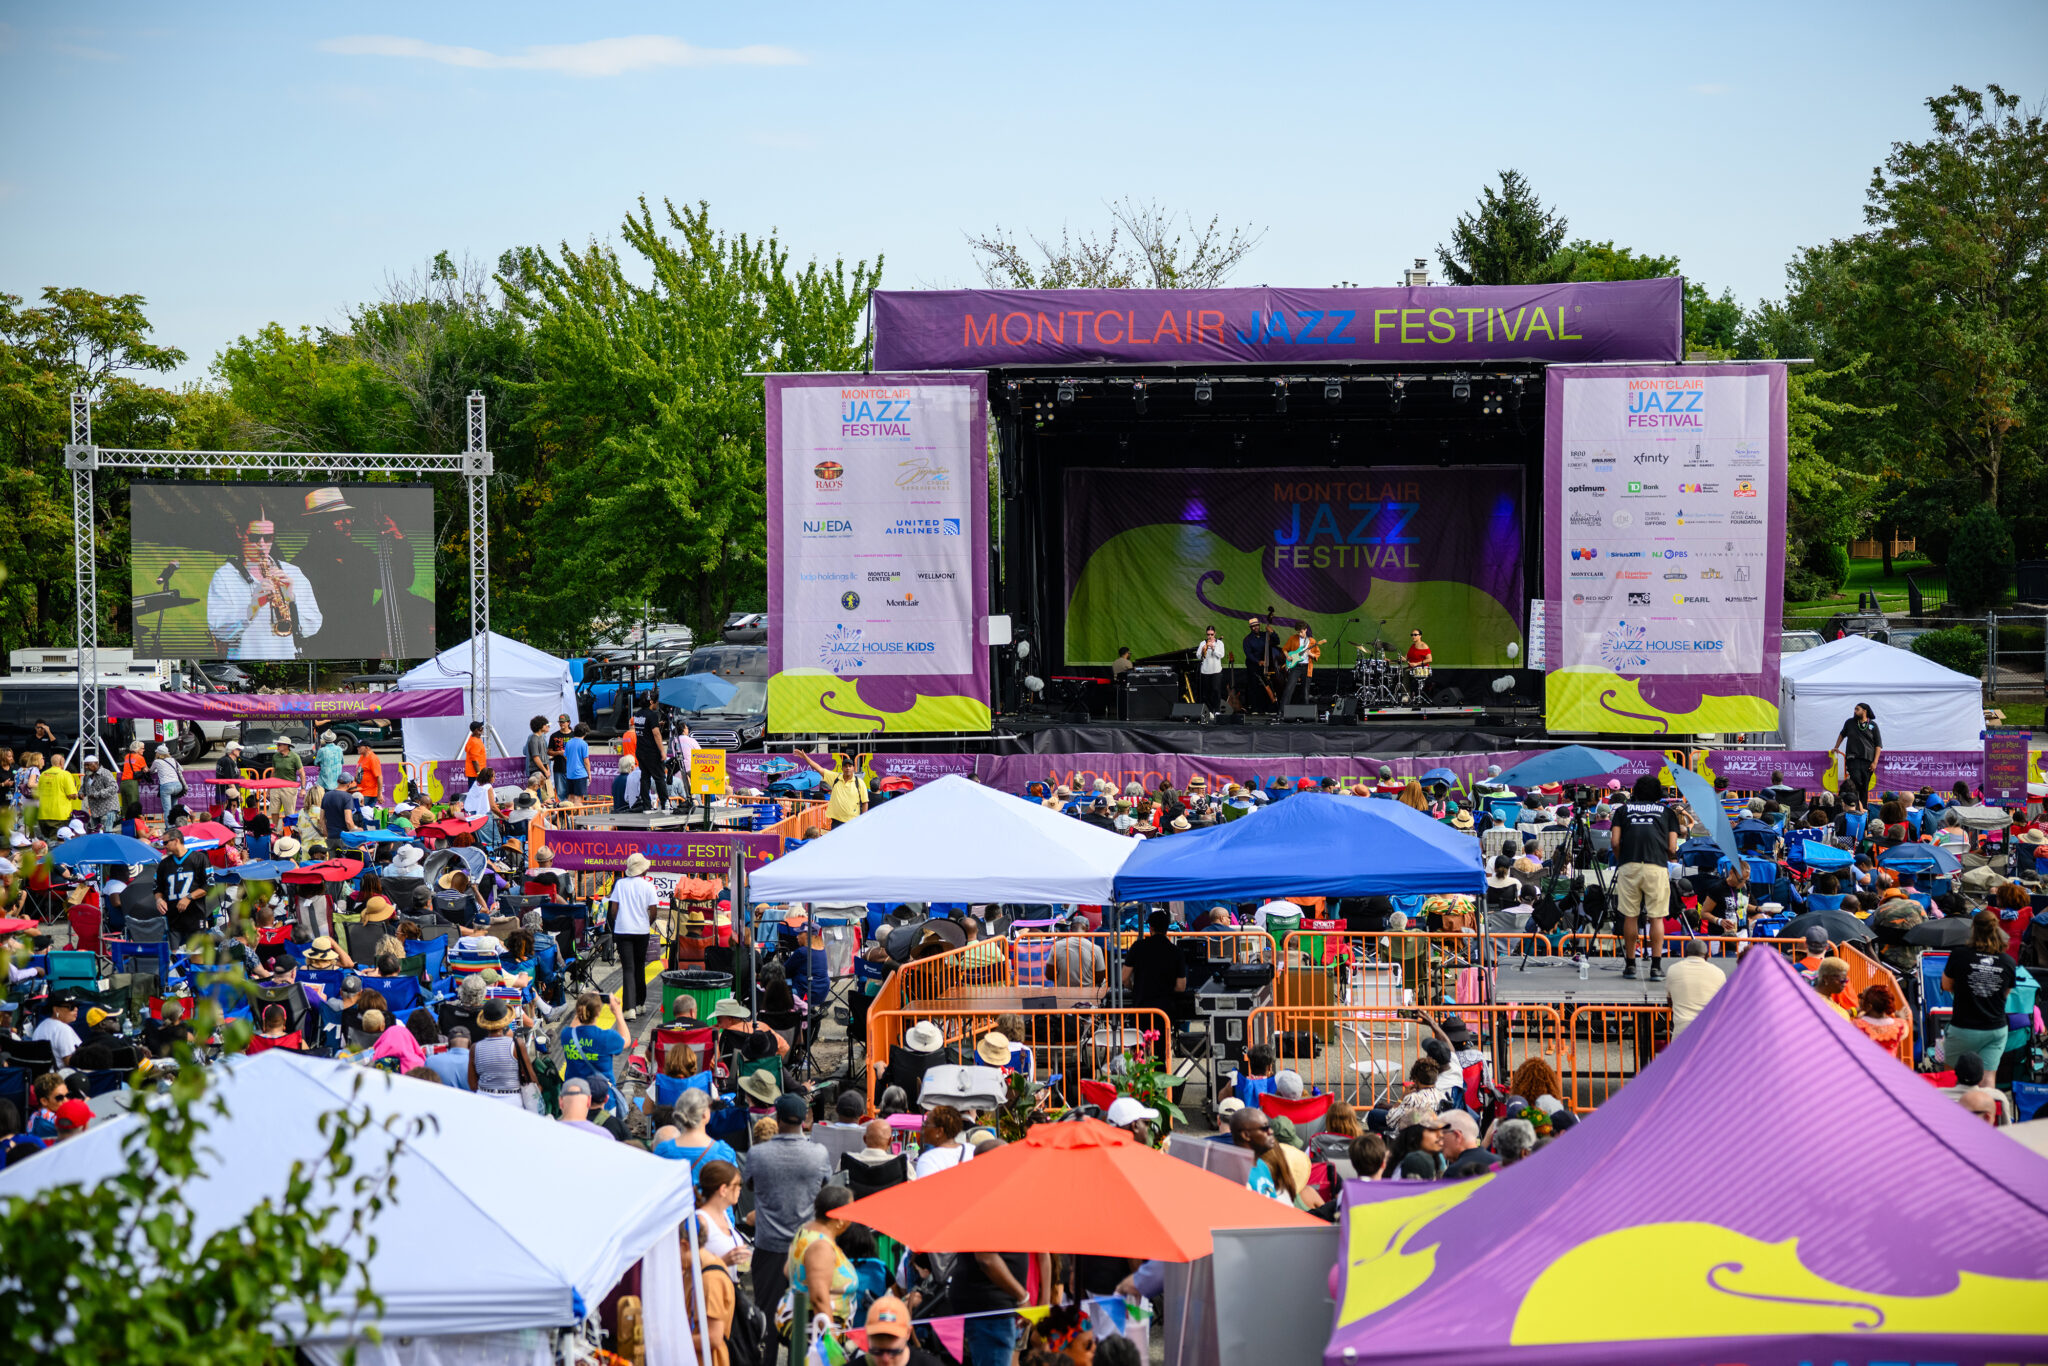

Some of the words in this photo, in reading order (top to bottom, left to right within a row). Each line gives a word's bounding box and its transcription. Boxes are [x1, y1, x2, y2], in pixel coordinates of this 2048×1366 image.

[964, 309, 1225, 347] MONTCLAIR
[1236, 310, 1356, 344] JAZZ
[1628, 379, 1704, 390] MONTCLAIR
[841, 389, 911, 400] MONTCLAIR
[1628, 391, 1704, 413] JAZZ
[841, 400, 911, 422] JAZZ
[1628, 414, 1704, 428] FESTIVAL
[841, 423, 911, 436] FESTIVAL
[1633, 452, 1670, 465] xfinity
[815, 480, 843, 489] RAO'S
[1678, 483, 1703, 493] CMA
[1273, 482, 1420, 501] MONTCLAIR
[896, 519, 940, 527] UNITED
[1273, 502, 1420, 545] JAZZ
[885, 527, 940, 535] AIRLINES
[1274, 545, 1420, 568] FESTIVAL
[817, 571, 846, 582] holdings
[830, 642, 860, 652] JAZZ
[862, 642, 903, 652] HOUSE
[906, 642, 935, 652] KiDS
[1612, 640, 1643, 650] JAZZ
[1646, 640, 1691, 650] HOUSE
[1693, 640, 1724, 650] KiDS
[203, 700, 277, 712] MONTCLAIR
[278, 701, 312, 712] JAZZ
[314, 700, 369, 711] FESTIVAL
[885, 764, 917, 773] JAZZ
[918, 764, 969, 773] FESTIVAL
[1723, 762, 1758, 770] JAZZ
[1759, 762, 1816, 771] FESTIVAL
[1884, 762, 1919, 770] JAZZ
[1921, 762, 1979, 771] FESTIVAL
[548, 841, 639, 856] MONTCLAIR
[642, 843, 683, 857] JAZZ
[672, 860, 695, 868] MUSIC
[167, 871, 194, 901] 17
